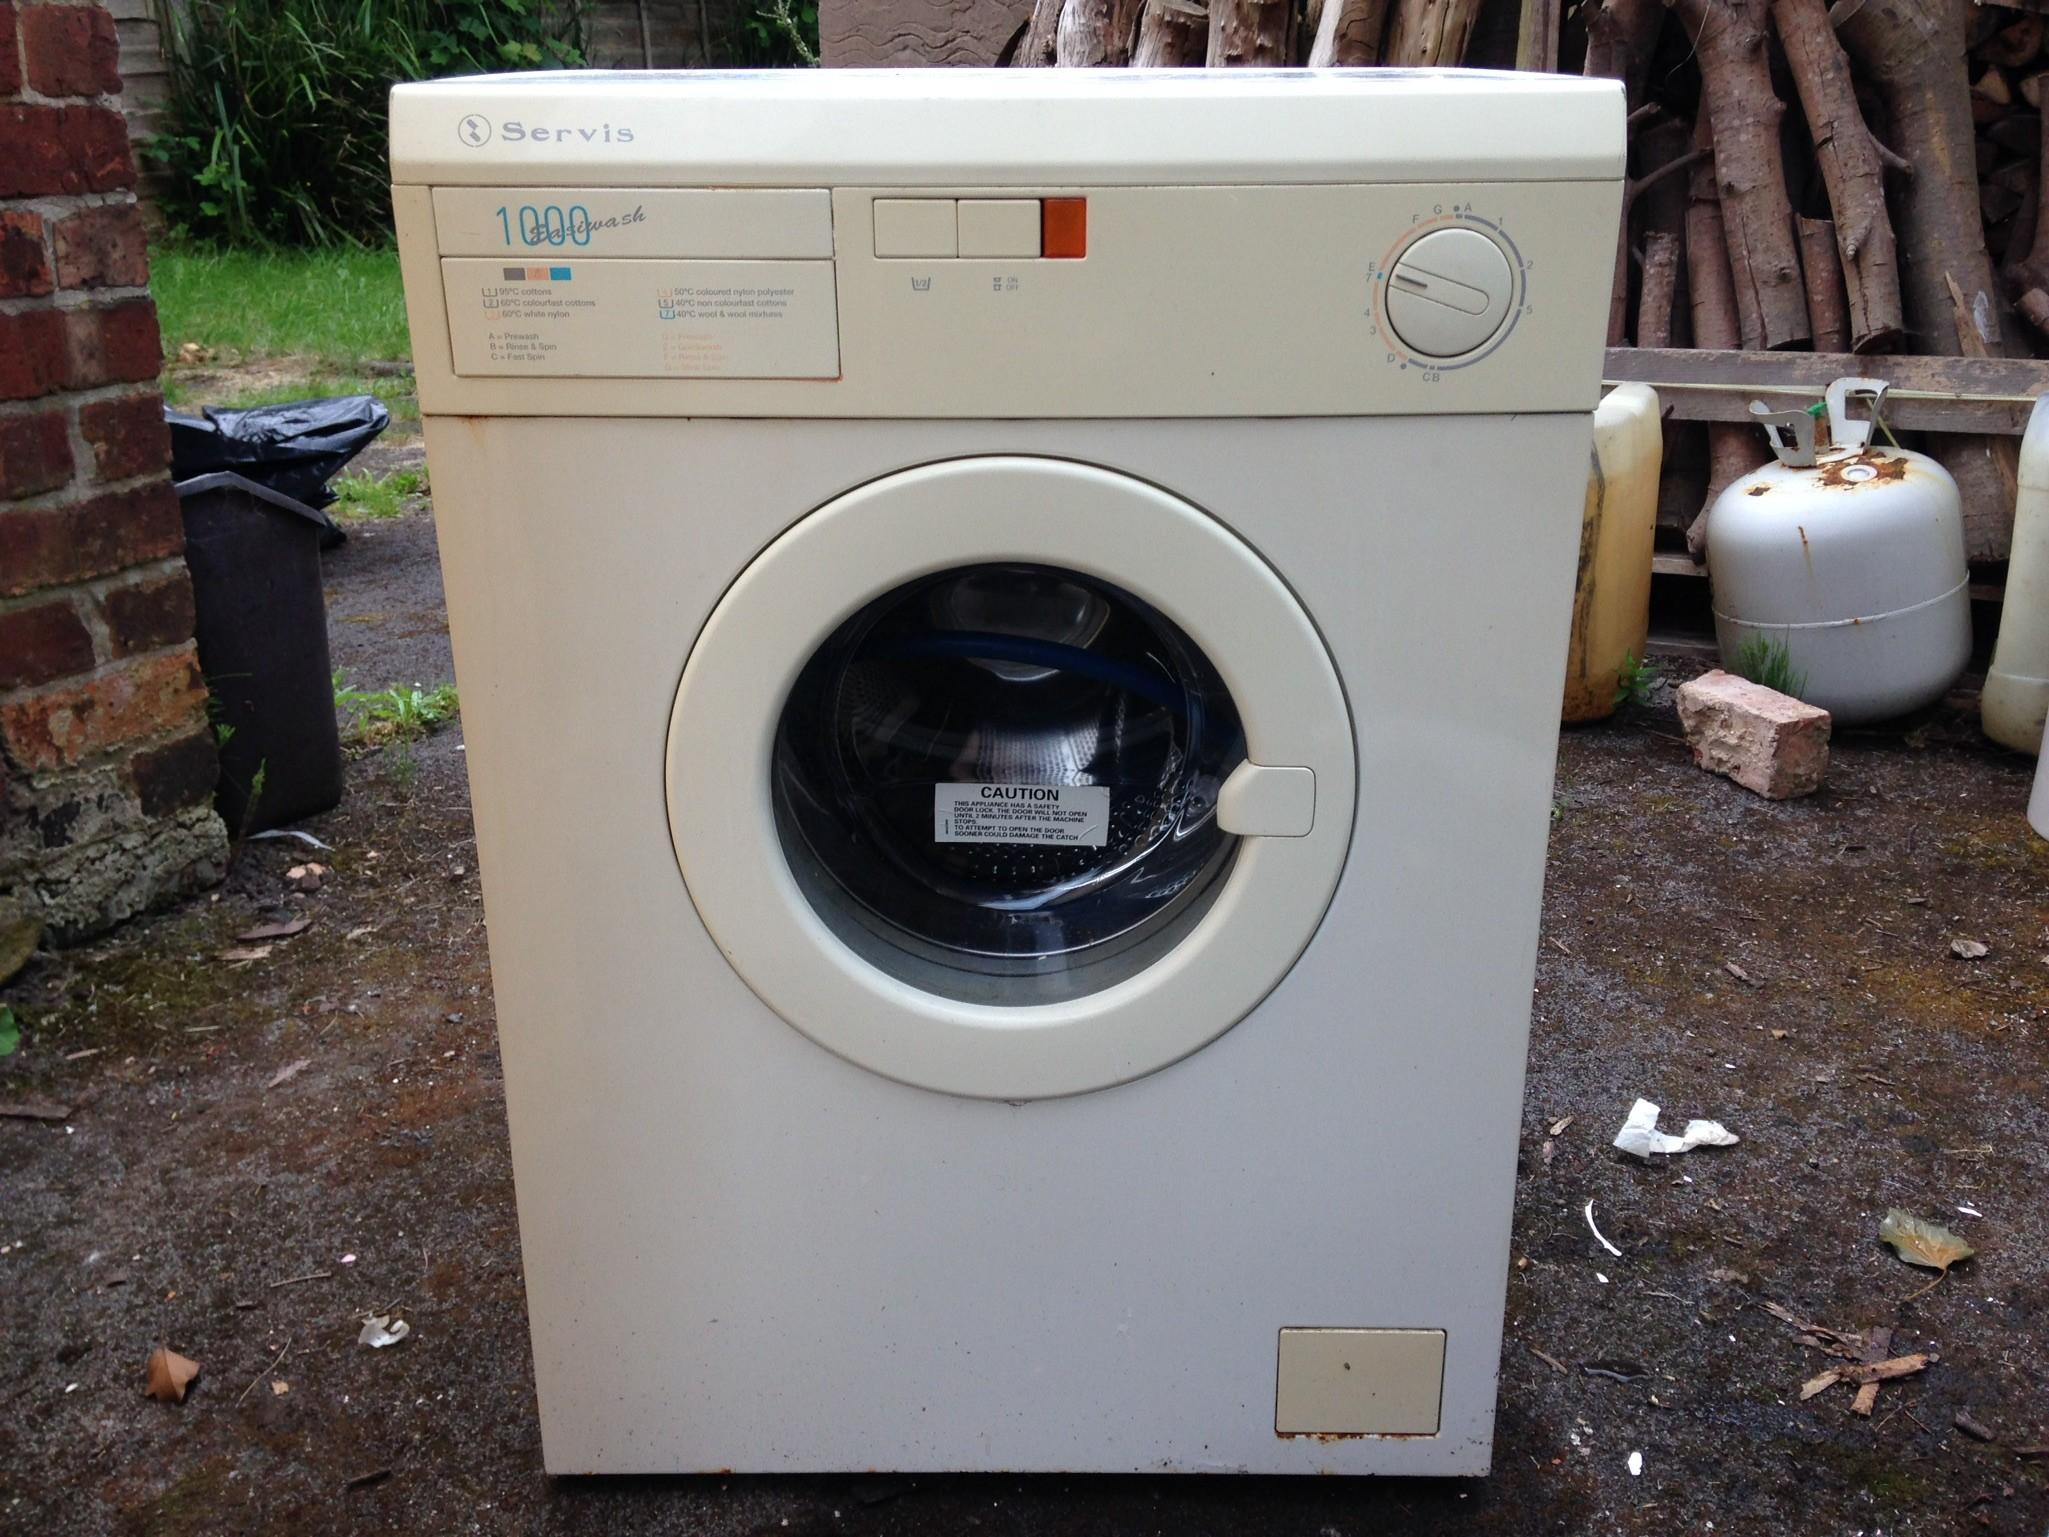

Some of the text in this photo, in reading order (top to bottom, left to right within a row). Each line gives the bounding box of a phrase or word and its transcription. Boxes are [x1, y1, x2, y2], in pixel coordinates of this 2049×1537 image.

[501, 121, 635, 143] Servis
[1464, 203, 1472, 212] A
[496, 205, 591, 246] 1000
[696, 288, 732, 296] coloured
[981, 786, 1059, 801] CAUTION
